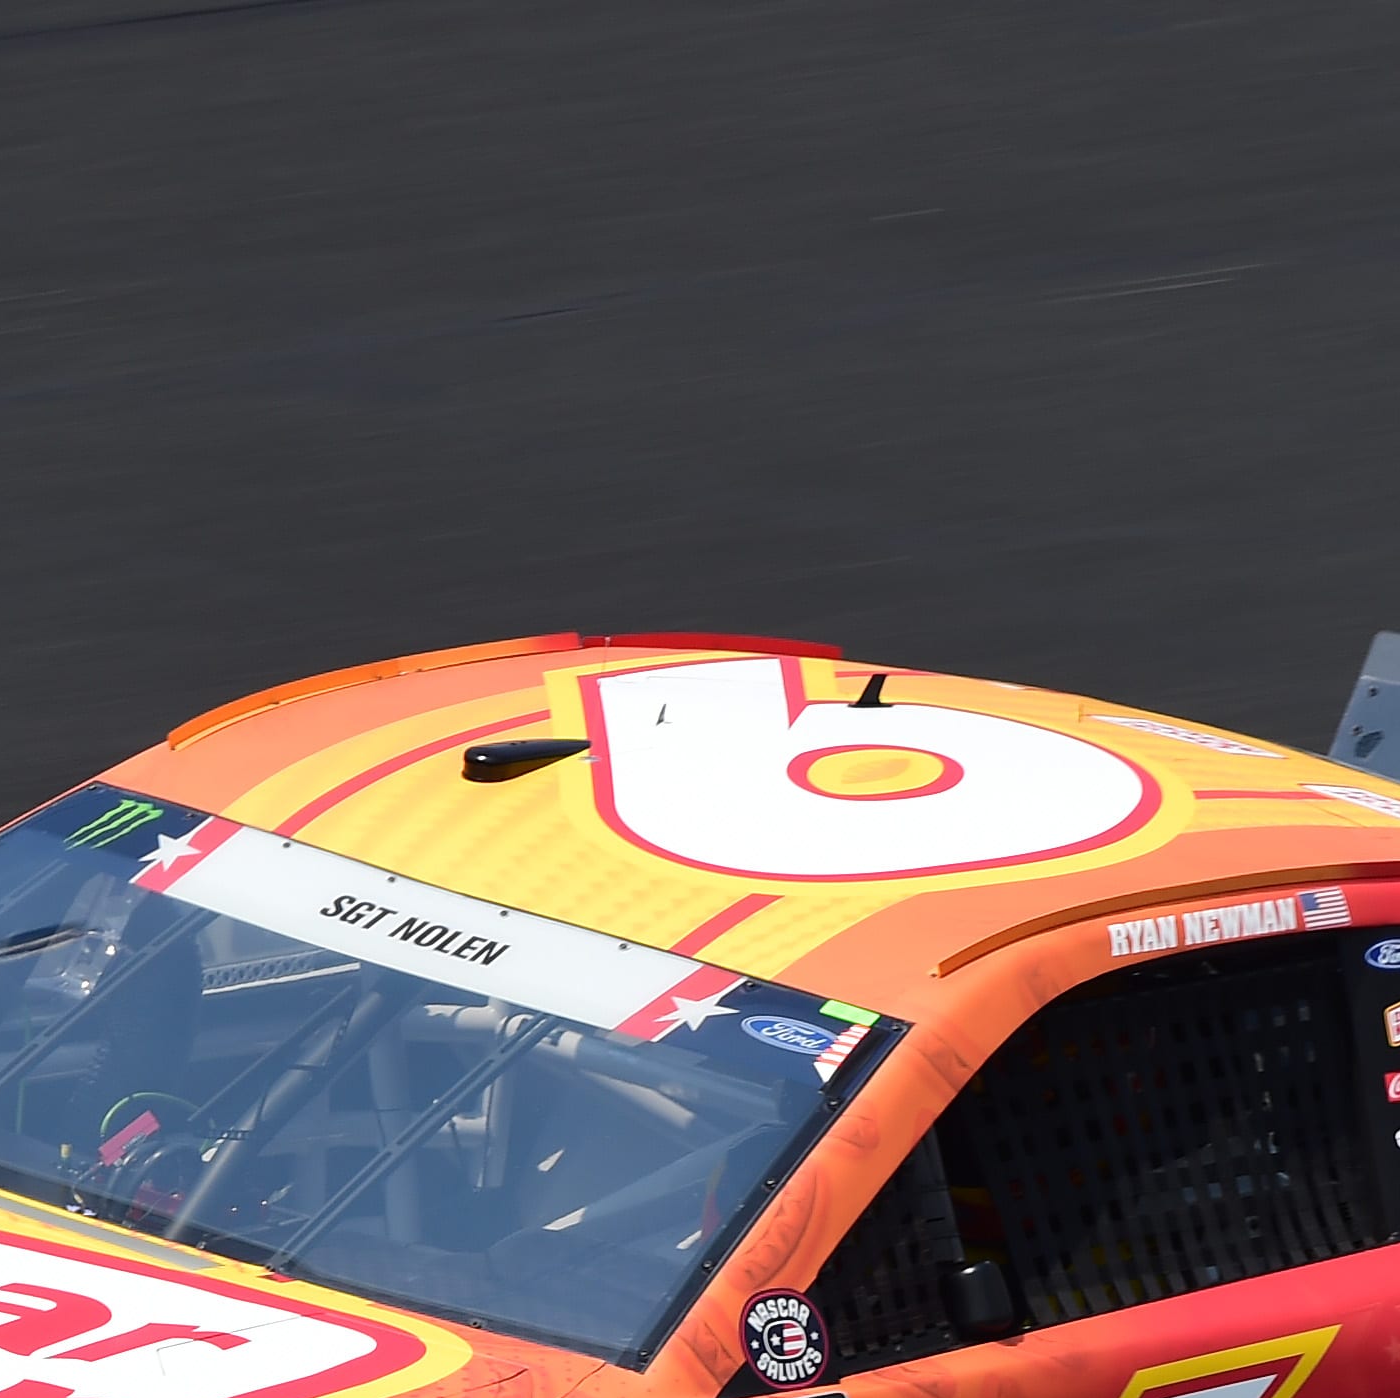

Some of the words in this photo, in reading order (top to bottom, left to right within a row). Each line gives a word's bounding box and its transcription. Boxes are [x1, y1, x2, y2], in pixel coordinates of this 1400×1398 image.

[321, 894, 395, 932] SGT
[391, 915, 510, 967] NOLEN
[1108, 915, 1178, 956] RYAN
[1183, 897, 1298, 945] NEWMAN
[761, 1021, 827, 1049] Ford
[747, 1298, 811, 1333] NASCAR
[757, 1347, 823, 1382] SALUTES
